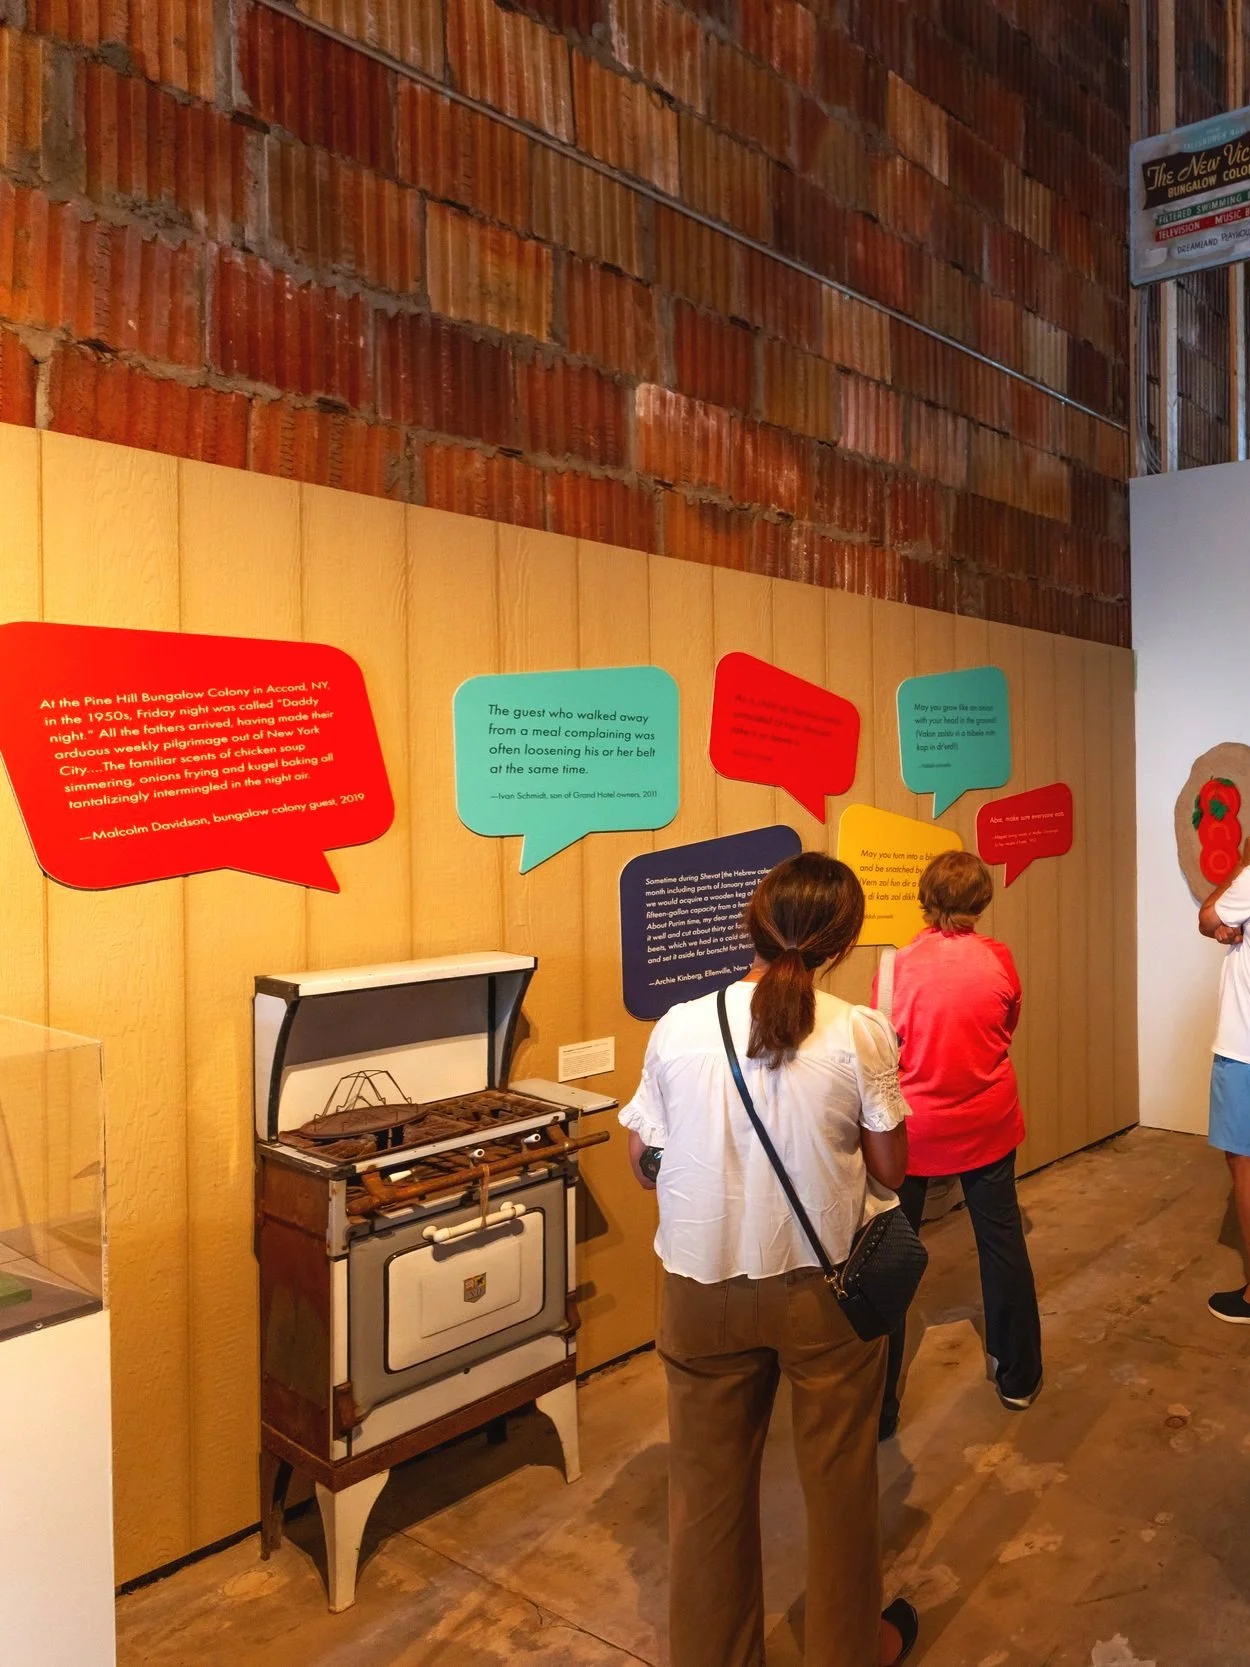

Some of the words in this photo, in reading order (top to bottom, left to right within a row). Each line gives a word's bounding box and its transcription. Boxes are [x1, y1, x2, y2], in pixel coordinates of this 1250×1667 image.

[1147, 163, 1174, 190] The
[1178, 152, 1221, 182] New
[1168, 175, 1217, 198] BUNGALOW
[1159, 208, 1192, 225] FILTERED
[1196, 194, 1242, 214] SWIMMING
[1158, 222, 1200, 240] TELEVISION
[1214, 209, 1241, 225] MUSIC
[40, 700, 55, 709] At
[59, 698, 80, 708] the
[84, 696, 112, 706] Pine
[116, 693, 138, 703] Hill
[142, 690, 204, 703] Bungalow
[208, 688, 250, 697] Colony
[44, 717, 56, 726] in
[61, 715, 82, 724] the
[88, 711, 132, 722] 1950s,
[137, 708, 176, 718] Friday
[180, 705, 209, 716] night
[239, 700, 274, 710] called
[99, 728, 116, 738] All
[120, 726, 140, 736] the
[144, 724, 185, 734] fathers
[188, 718, 233, 730] arrived,
[237, 717, 275, 726] having
[278, 712, 308, 722] made
[312, 711, 334, 719] their
[488, 704, 510, 716] The
[513, 709, 545, 719] guest
[549, 707, 573, 719] who
[577, 710, 616, 720] walked
[620, 715, 648, 725] away
[54, 748, 110, 759] arduous
[114, 741, 159, 753] weekly
[163, 737, 228, 751] pilgrimage
[232, 734, 249, 742] out
[252, 730, 264, 740] of
[267, 730, 294, 738] New
[297, 726, 320, 735] York
[489, 723, 516, 735] from
[532, 726, 561, 736] meal
[564, 728, 631, 742] complaining
[129, 757, 176, 768] familiar
[180, 753, 216, 763] scents
[220, 748, 231, 758] of
[234, 746, 276, 757] chicken
[280, 744, 306, 752] soup
[489, 743, 520, 754] often
[524, 744, 580, 758] loosening
[585, 745, 599, 756] his
[617, 746, 634, 756] her
[636, 747, 655, 757] belt
[64, 779, 135, 792] simmering,
[140, 774, 181, 783] onions
[184, 769, 219, 779] frying
[222, 763, 245, 774] and
[248, 760, 278, 771] kugel
[281, 757, 318, 767] baking
[321, 753, 334, 762] all
[490, 765, 502, 774] at
[506, 762, 524, 774] the
[563, 764, 588, 774] time.
[69, 791, 149, 808] tantalizingly
[154, 780, 228, 798] intermingled
[244, 777, 261, 786] the
[265, 774, 291, 785] night
[294, 772, 310, 780] air.
[151, 818, 210, 832] Davidson,
[212, 808, 269, 822] bungalow
[272, 804, 306, 814] colony
[309, 799, 337, 810] guest,
[340, 793, 364, 804] 2019
[861, 850, 876, 860] May
[860, 864, 874, 872] and
[875, 864, 884, 872] be
